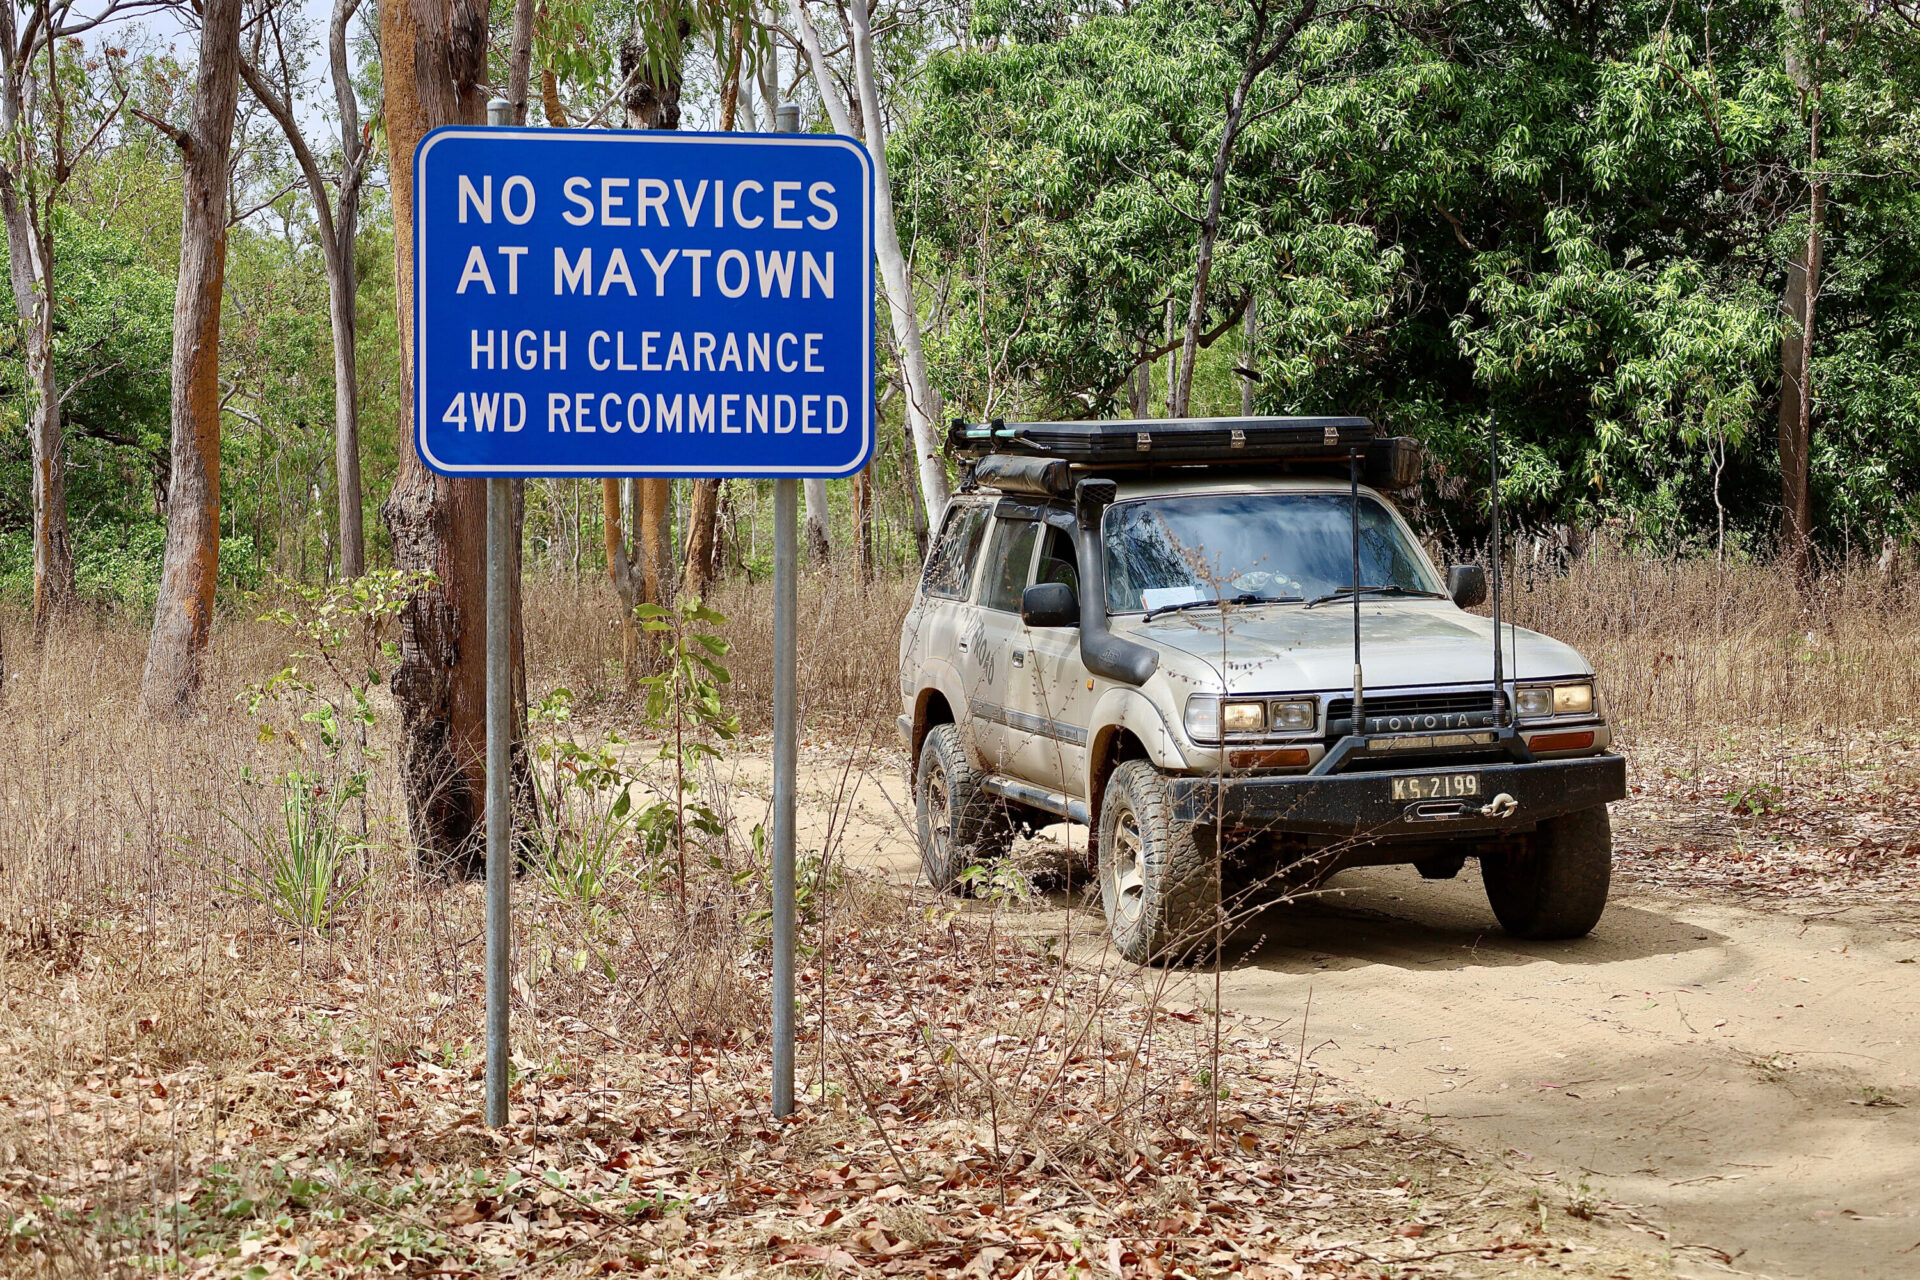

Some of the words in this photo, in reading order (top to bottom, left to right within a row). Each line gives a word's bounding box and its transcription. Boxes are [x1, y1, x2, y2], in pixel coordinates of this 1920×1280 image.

[458, 175, 536, 225] NO
[562, 176, 839, 231] SERVICES
[456, 246, 528, 294] AT
[554, 247, 834, 299] MAYTOWN
[471, 329, 567, 370] HIGH
[588, 331, 825, 373] CLEARANCE
[442, 392, 527, 433] 4WD
[548, 393, 849, 434] RECOMMENDED
[1372, 713, 1469, 731] TOYOTA
[1394, 779, 1421, 800] KS
[1430, 775, 1477, 798] 2199
